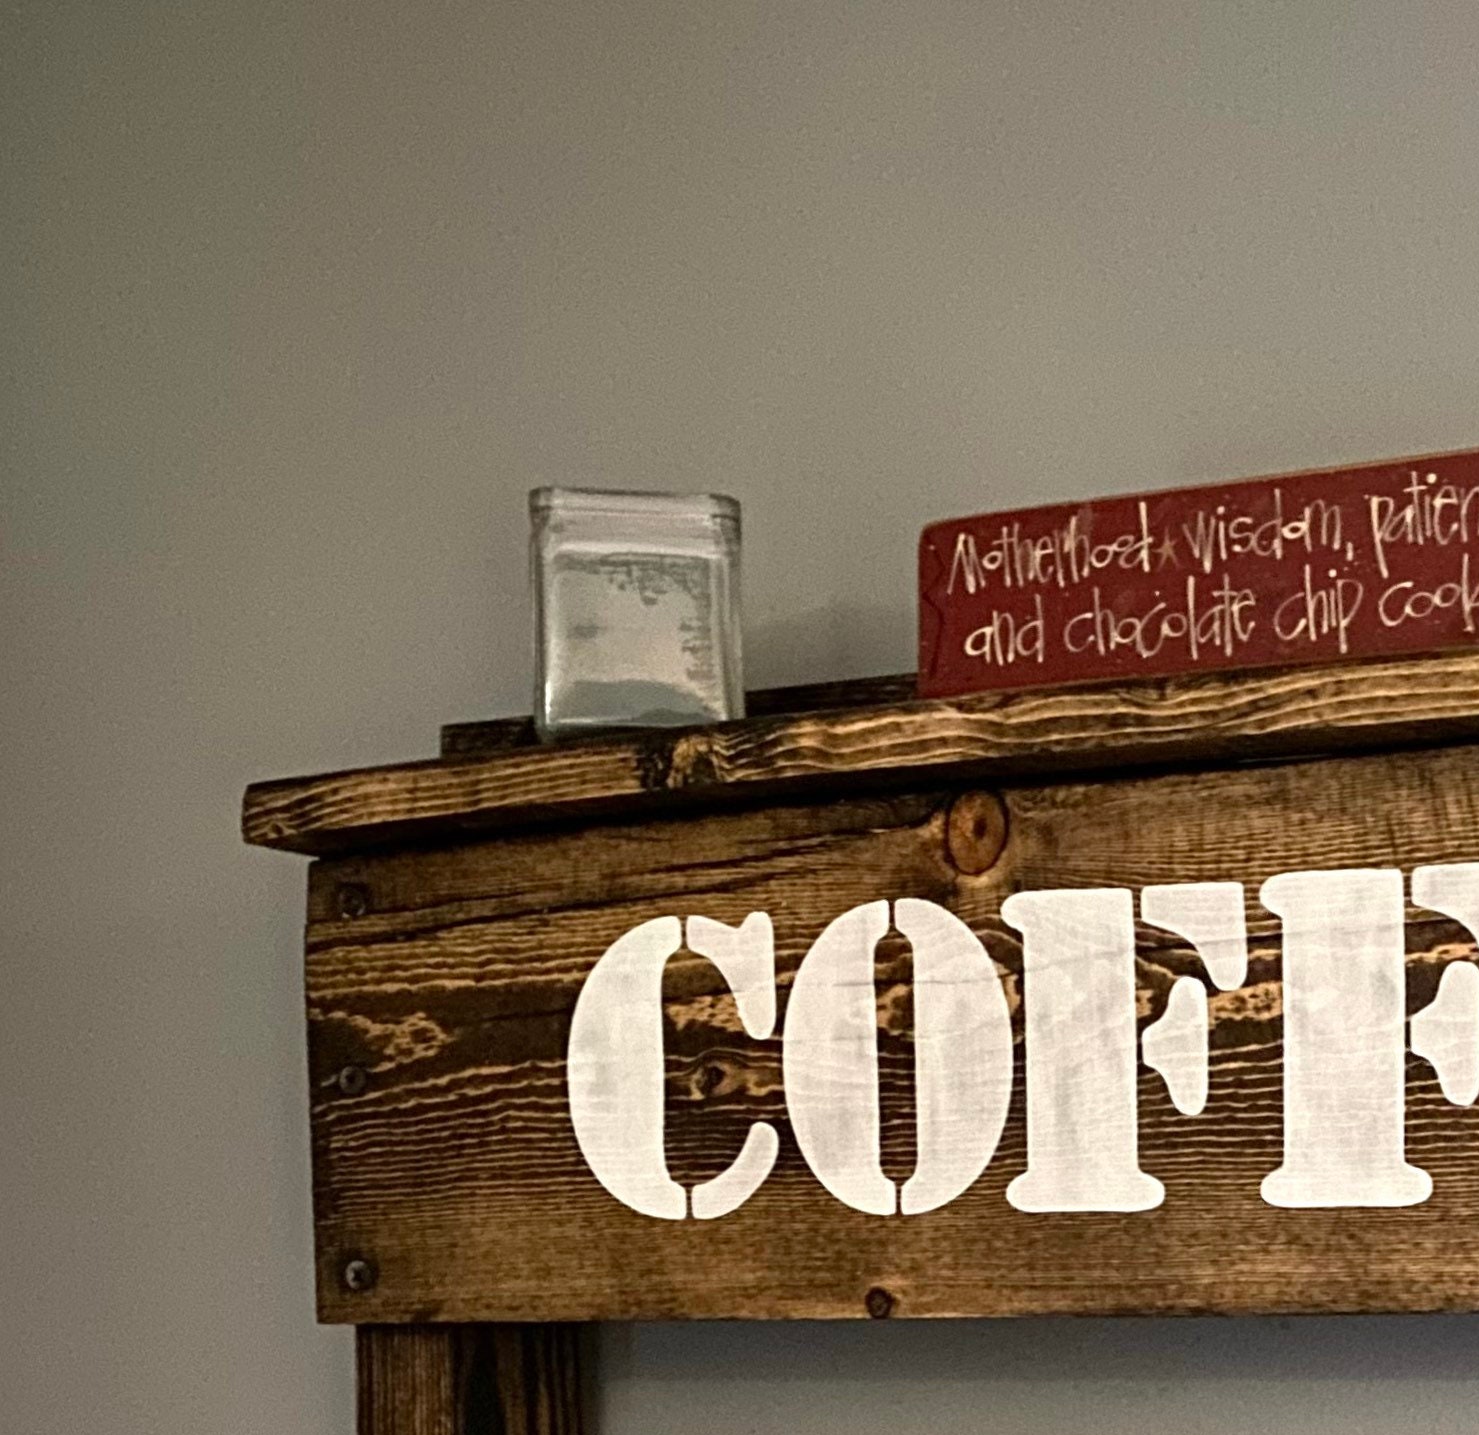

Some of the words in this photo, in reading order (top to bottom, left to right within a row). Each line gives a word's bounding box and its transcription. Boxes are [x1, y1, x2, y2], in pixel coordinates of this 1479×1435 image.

[947, 500, 1153, 594] Motherhood
[964, 593, 1045, 666] and
[1064, 574, 1257, 660] chocolate
[1274, 563, 1364, 654] chip
